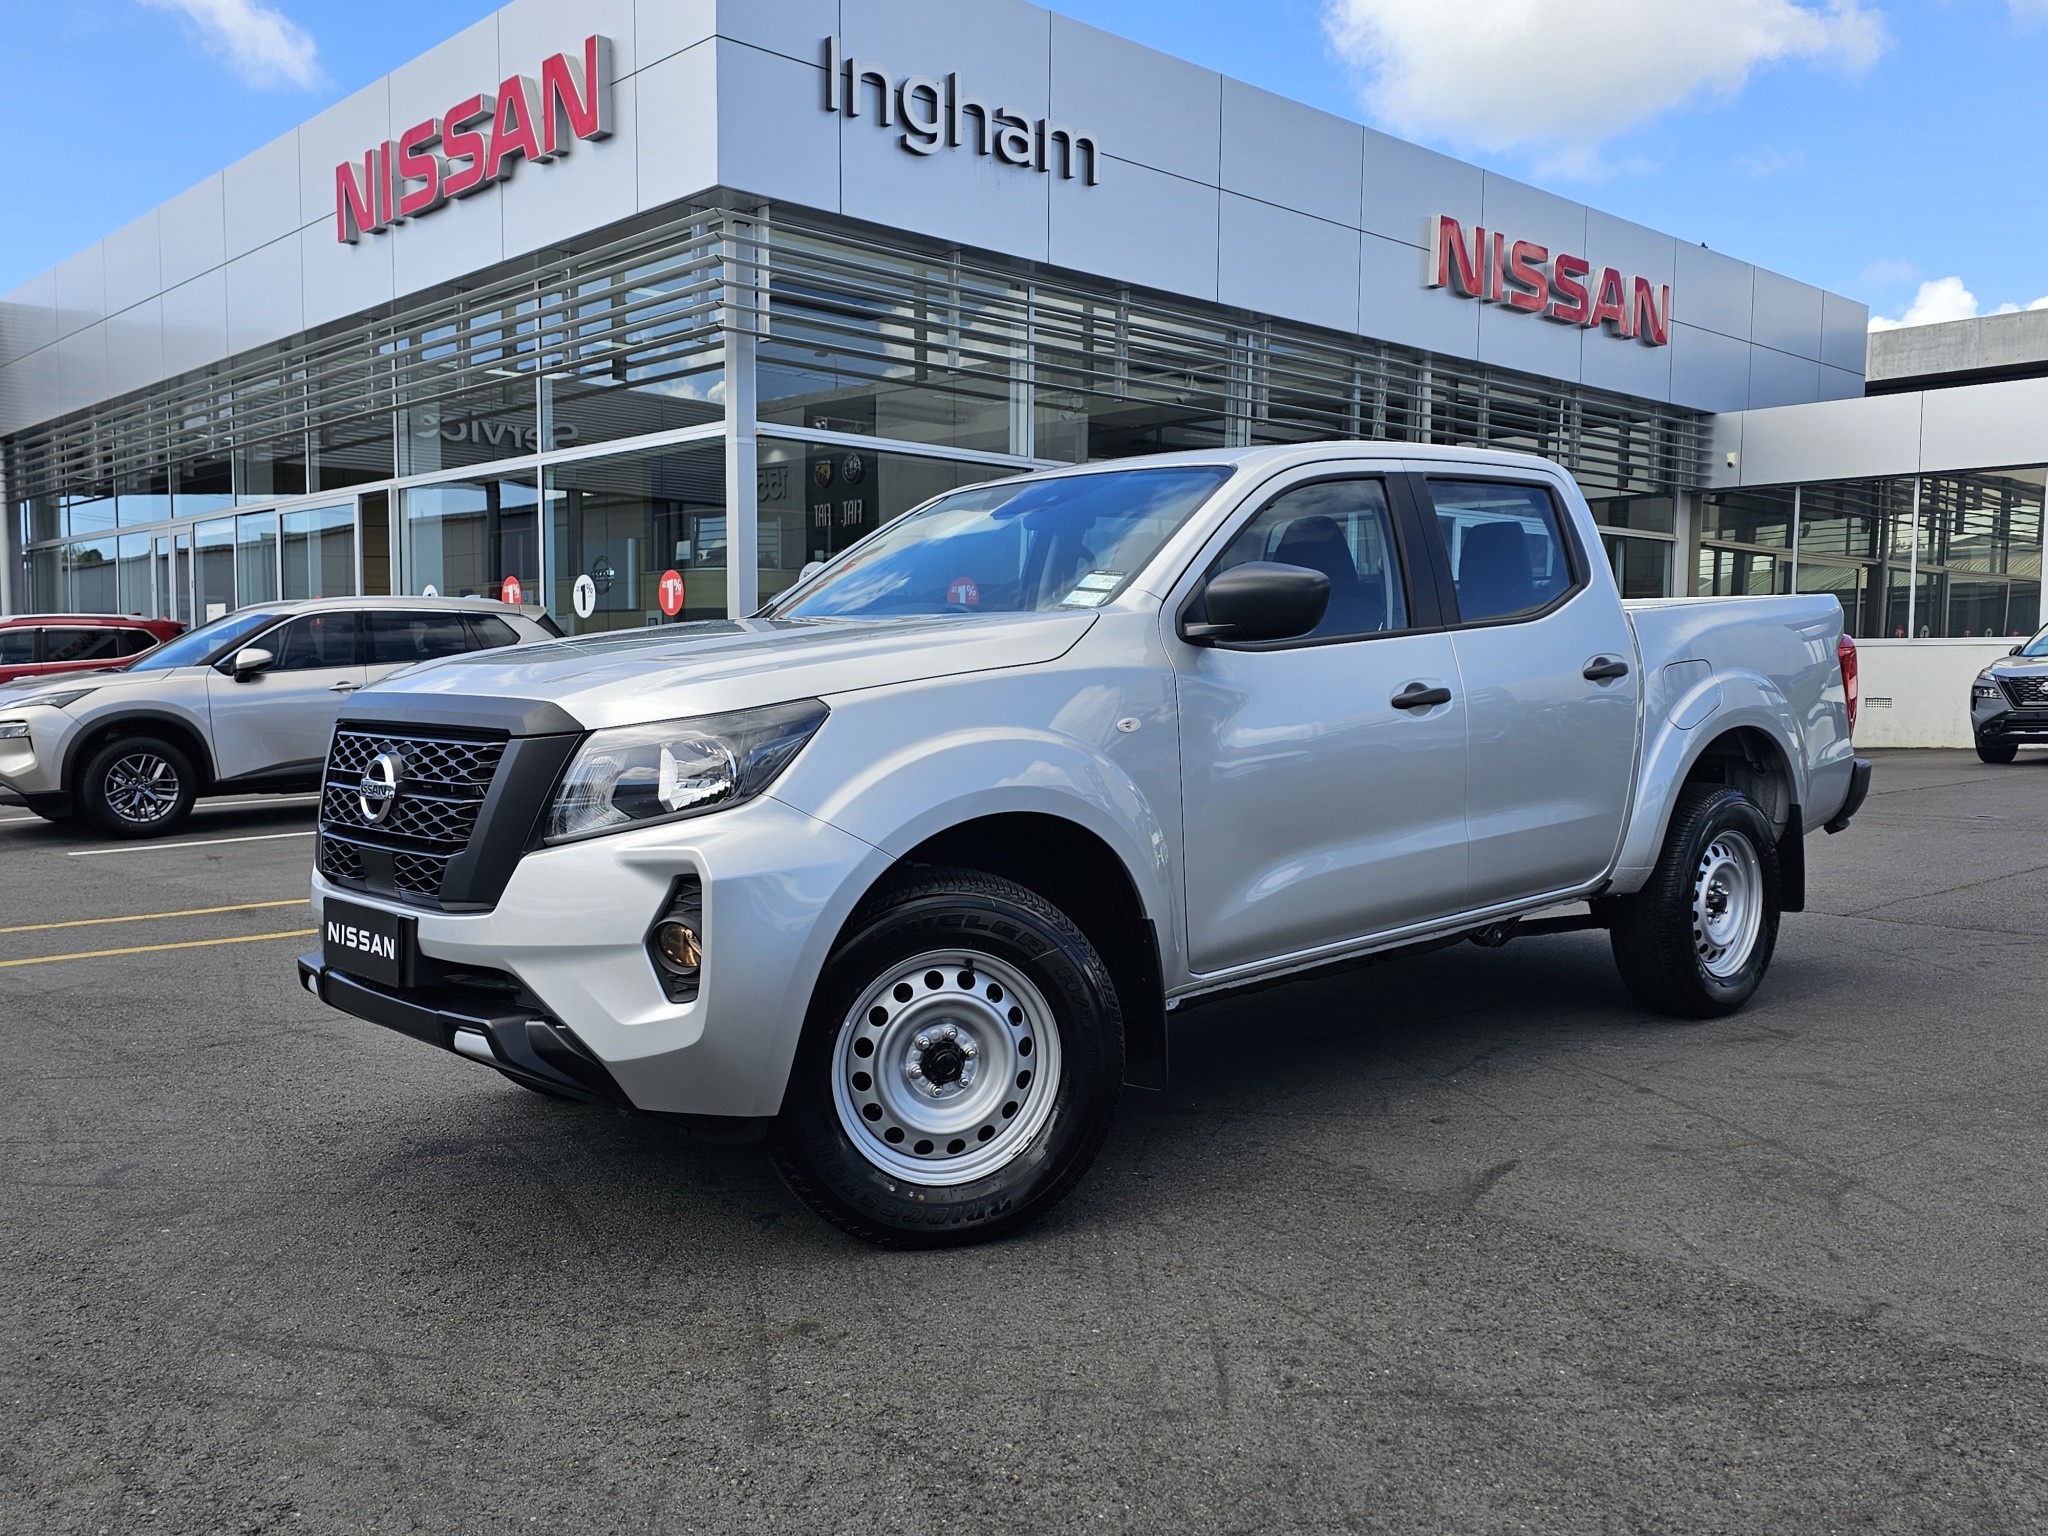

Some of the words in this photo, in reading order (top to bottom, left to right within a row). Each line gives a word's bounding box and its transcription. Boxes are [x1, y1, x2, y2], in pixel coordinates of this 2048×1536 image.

[335, 33, 612, 244] NISSAN
[822, 35, 1100, 187] Ingham
[1428, 213, 1670, 346] NISSAN
[327, 920, 396, 961] NISSAN
